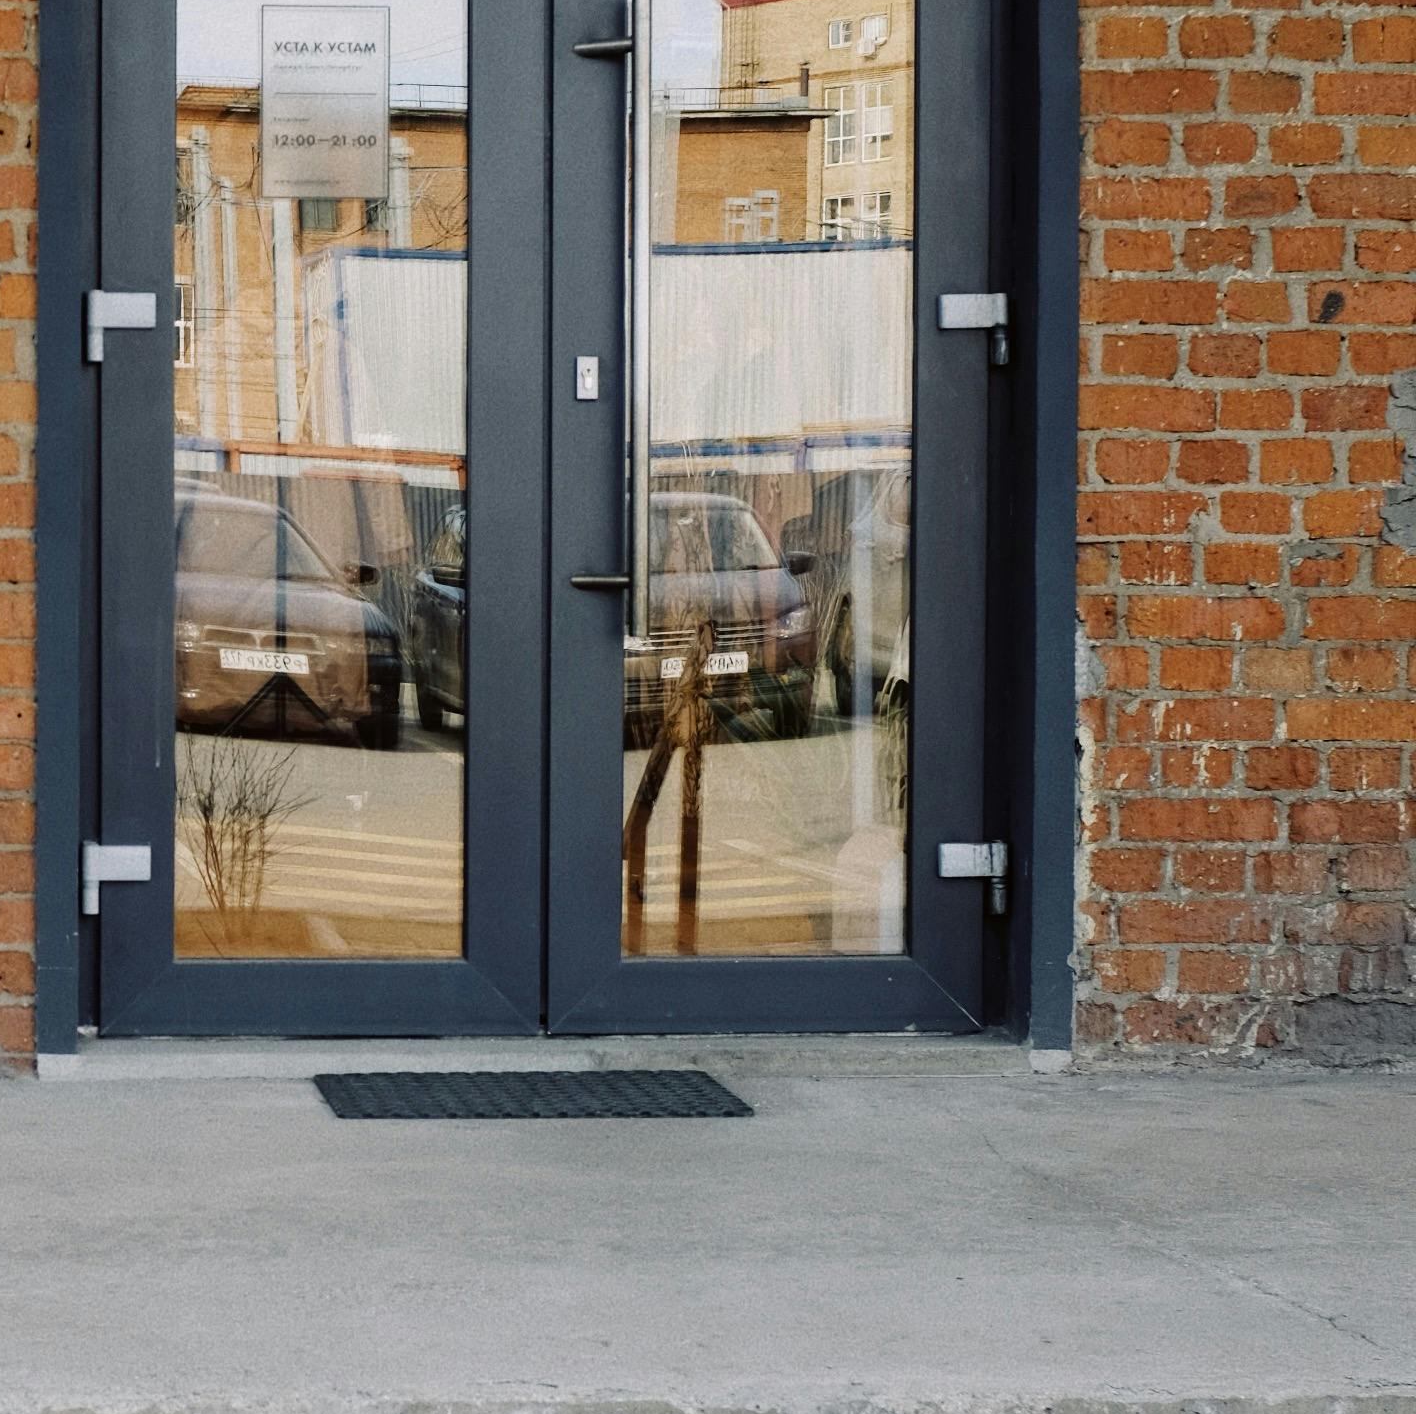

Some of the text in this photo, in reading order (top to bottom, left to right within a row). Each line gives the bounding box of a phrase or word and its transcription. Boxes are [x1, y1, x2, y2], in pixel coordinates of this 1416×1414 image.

[274, 42, 377, 54] УСТА К УСТАМ
